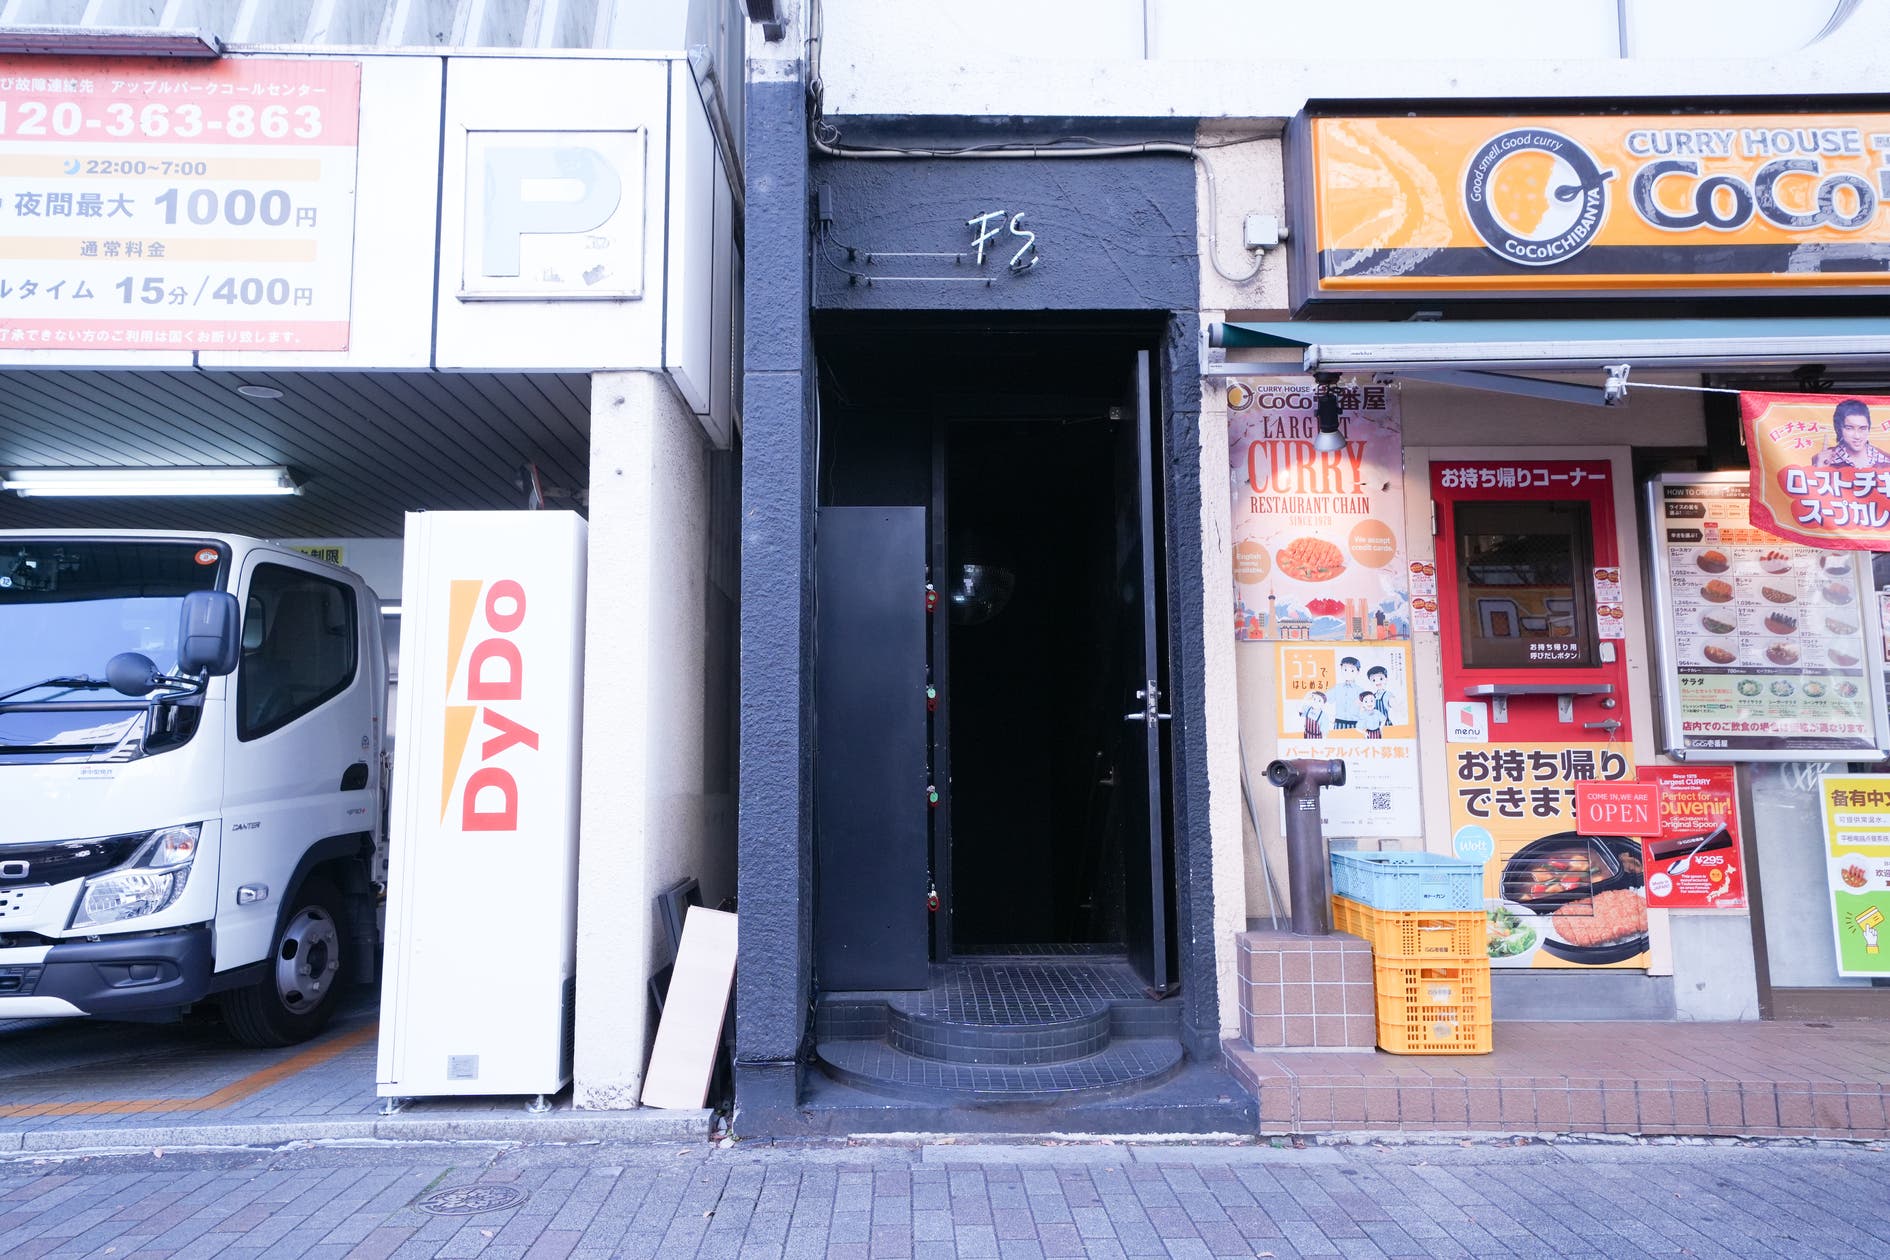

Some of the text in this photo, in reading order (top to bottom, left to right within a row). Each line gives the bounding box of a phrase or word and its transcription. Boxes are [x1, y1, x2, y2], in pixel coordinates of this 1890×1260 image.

[1628, 129, 1861, 155] CURRY HOUSE
[1471, 169, 1484, 202] Good
[1533, 136, 1563, 151] curry
[14, 191, 136, 218] 夜間最大
[482, 147, 622, 277] P
[80, 240, 166, 258] 通常料金
[1258, 386, 1386, 410] CoCo番屋
[1263, 416, 1351, 439] LARGT
[1248, 440, 1367, 494] CURRY
[1441, 467, 1606, 488] お持ち帰りコーナー
[1250, 496, 1370, 514] RESTAURANT CHAIN
[301, 549, 339, 564] 制限
[1530, 643, 1577, 651] お持ち帰り用
[1530, 652, 1577, 660] 呼びだしボタン
[1292, 680, 1329, 690] はじめる!
[1681, 678, 1704, 686] サラダ
[462, 579, 539, 832] DyDo
[1454, 728, 1481, 736] menu
[1458, 750, 1626, 782] お持ち帰り
[1660, 778, 1685, 786] Largest
[1662, 792, 1711, 801] Perfect for
[1590, 803, 1648, 823] OPEN
[1660, 798, 1732, 815] ouvenir!
[232, 822, 261, 831] CANTER
[1661, 821, 1718, 829] Original Spoon
[1460, 842, 1487, 851] Wolt
[1695, 856, 1724, 865] ¥295
